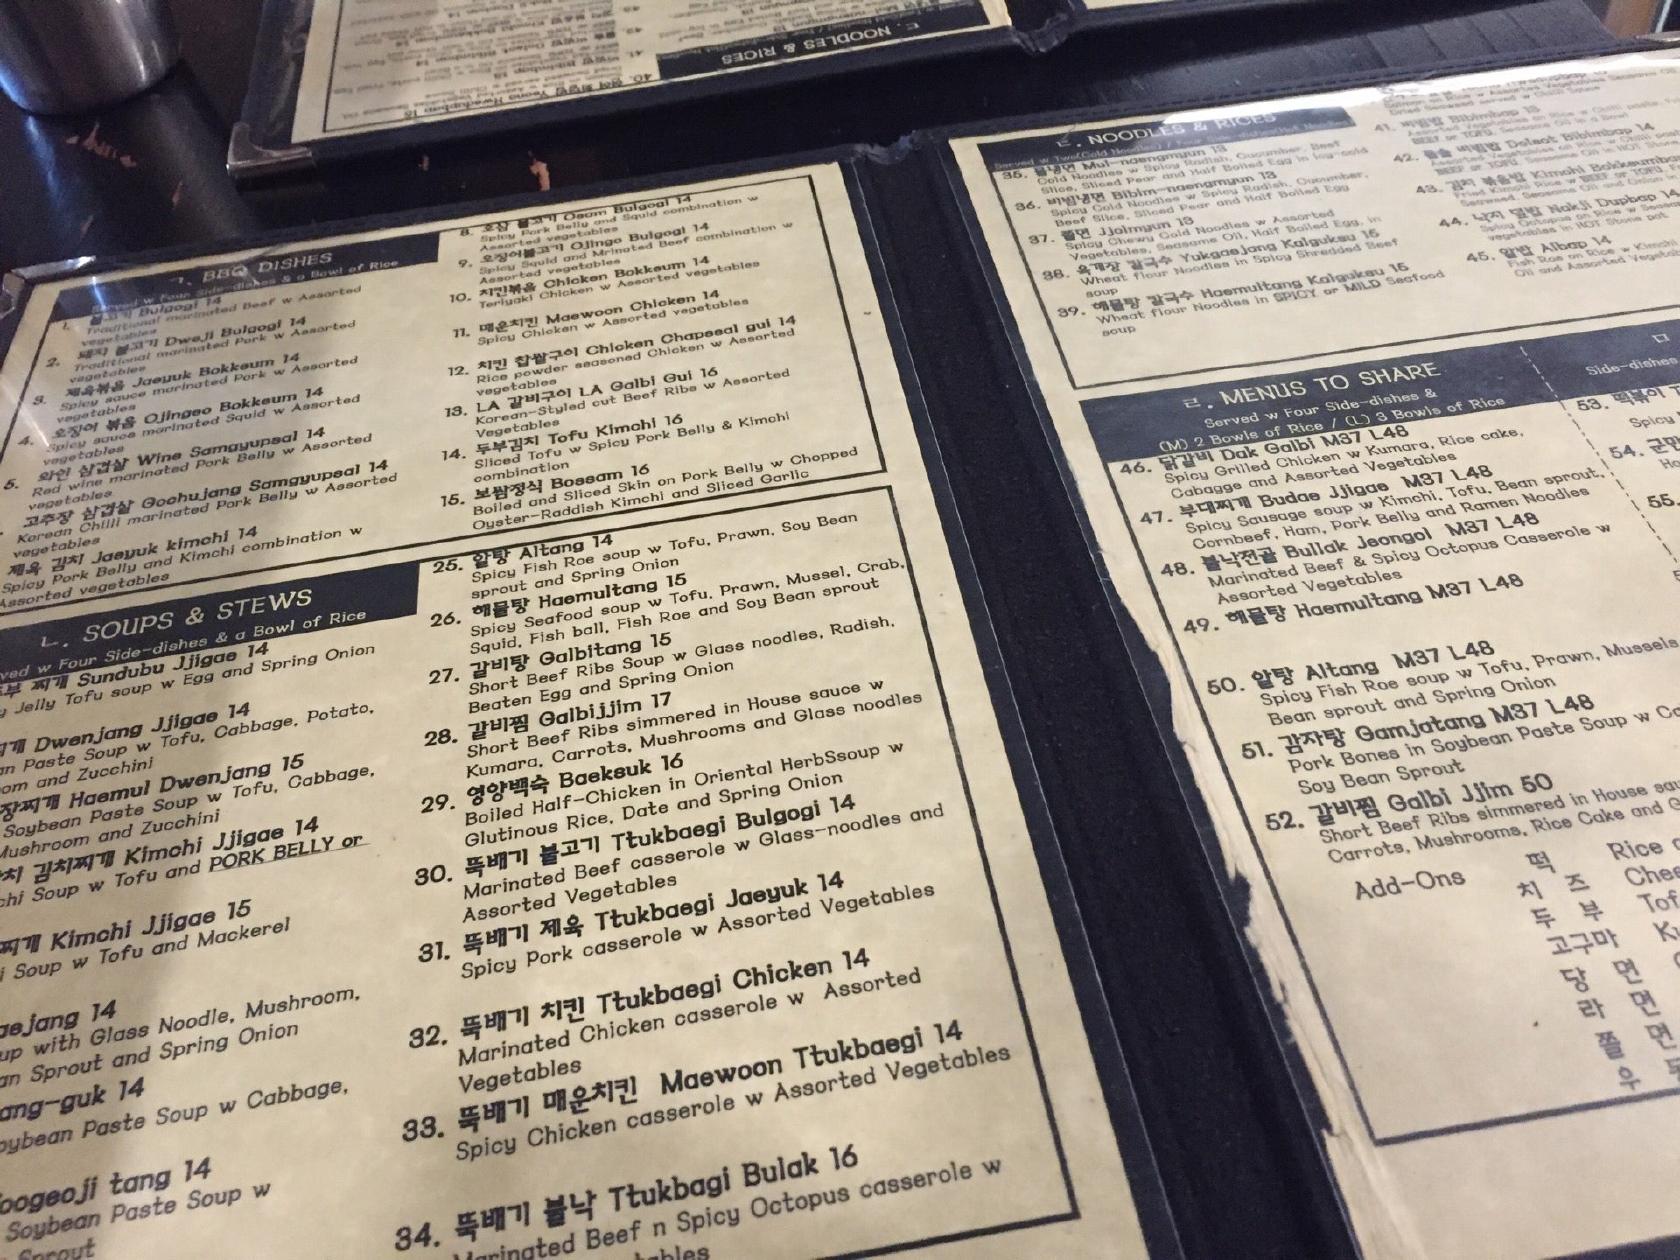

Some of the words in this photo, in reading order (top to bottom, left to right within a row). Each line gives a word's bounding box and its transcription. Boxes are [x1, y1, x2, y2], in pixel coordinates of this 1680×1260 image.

[803, 26, 891, 49] NOODLES
[450, 292, 471, 303] 10.
[479, 278, 536, 299] 치킨볶음
[543, 271, 607, 289] Chicken
[614, 260, 686, 279] Bokkeum
[692, 254, 709, 268] 14
[1095, 307, 1145, 325] Wheat
[1150, 304, 1187, 317] flour
[1192, 295, 1250, 312] Noodles
[1254, 292, 1269, 303] in
[1272, 284, 1315, 301] SPICY
[1323, 284, 1338, 294] or
[1342, 276, 1381, 291] MILD
[1385, 267, 1445, 286] Seafood
[453, 327, 470, 339] 11.
[479, 312, 538, 335] 매운치킨
[545, 304, 623, 324] Maewoon
[629, 293, 696, 312] Chicken
[702, 287, 719, 302] 14
[477, 331, 515, 346] Spicy
[521, 322, 578, 338] Chicken
[584, 320, 595, 329] w
[602, 307, 666, 327] Assorted
[672, 297, 749, 317] vegetables
[1218, 378, 1306, 407] MENUS
[1312, 373, 1349, 395] TO
[1358, 360, 1441, 389] SHARE
[442, 448, 466, 461] 14.
[475, 431, 539, 455] 두부김치
[547, 426, 588, 444] Tofu
[595, 415, 656, 437] Kimchi
[664, 411, 683, 426] 16
[1121, 461, 1152, 476] 46.
[1219, 443, 1259, 461] Dak
[1264, 436, 1315, 455] Galbi
[1320, 431, 1360, 448] M37
[1369, 425, 1409, 442] L48
[441, 492, 465, 507] 15.
[474, 475, 542, 502] 보쌈정식
[550, 468, 623, 489] Bossam
[631, 461, 649, 477] 16
[473, 496, 521, 516] Boiled
[528, 490, 556, 507] and
[563, 482, 611, 502] Sliced
[618, 477, 650, 493] Skin
[657, 475, 675, 487] on
[681, 465, 717, 484] Pork
[723, 459, 763, 477] Belly
[770, 458, 783, 470] w
[789, 443, 858, 467] Chopped
[51, 549, 84, 570] 김치
[91, 539, 158, 563] Jaeyuk
[165, 529, 228, 551] kimchi
[238, 524, 257, 540] 14
[433, 558, 463, 574] 25.
[472, 547, 511, 570] 알탕
[519, 540, 584, 561] Altang
[592, 532, 613, 550] 14
[471, 564, 515, 584] Spicy
[523, 555, 557, 574] Fish
[563, 553, 594, 568] Roe
[602, 546, 640, 562] soup
[647, 542, 661, 555] w
[781, 519, 810, 535] Soy
[816, 512, 857, 529] Bean
[1161, 562, 1195, 577] 48.
[1281, 535, 1348, 558] Bullak
[1357, 524, 1432, 548] Jeongol
[1444, 517, 1488, 537] M37
[1495, 510, 1539, 530] L48
[82, 610, 173, 643] SOUPS
[184, 605, 204, 626] &
[216, 587, 312, 621] STEWS
[430, 613, 461, 627] 26.
[538, 580, 657, 609] Haemultang
[666, 571, 686, 590] 15
[37, 662, 52, 674] w
[58, 654, 97, 671] Four
[104, 636, 207, 663] Side-dishes
[215, 630, 228, 645] &
[235, 630, 245, 642] a
[253, 619, 295, 639] Bowl
[302, 615, 322, 631] of
[329, 610, 366, 626] Rice
[429, 669, 459, 684] 27.
[469, 652, 530, 680] 갈비탕
[539, 639, 641, 668] Galbitang
[650, 631, 671, 650] 15
[1207, 677, 1245, 695] 50.
[1251, 664, 1294, 687] 알탕
[1305, 658, 1378, 679] Altang
[1391, 647, 1439, 668] M37
[1448, 640, 1495, 661] L48
[33, 724, 143, 752] Dwenjang
[150, 711, 218, 735] Jjigae
[229, 703, 250, 721] 14
[421, 794, 456, 813] 29.
[466, 772, 549, 805] 영양백숙
[558, 757, 652, 789] Baeksuk
[660, 752, 683, 773] 16
[1265, 812, 1304, 831] 52.
[1309, 795, 1379, 824] 갈비찜
[1387, 787, 1452, 812] Galbi
[1462, 780, 1514, 803] Jjim
[1520, 773, 1553, 793] 50
[1297, 779, 1335, 794] Soy
[1340, 771, 1390, 788] Bean
[1395, 758, 1465, 783] Sprout
[414, 864, 452, 886] 30.
[464, 846, 528, 878] 뚝배기
[539, 834, 599, 865] 불고기
[611, 815, 725, 852] Ttukbaegi
[735, 799, 820, 831] Bulgogi
[829, 793, 855, 815] 14
[1356, 872, 1466, 900] Add-Ons
[13, 960, 62, 980] Soup
[72, 955, 88, 969] w
[100, 944, 143, 964] Tofu
[151, 935, 188, 956] and
[197, 917, 290, 948] Mackerel
[50, 920, 131, 951] Kimchi
[141, 909, 216, 938] Jjigae
[228, 899, 250, 921] 15
[33, 1029, 80, 1054] with
[89, 1022, 149, 1044] Glass
[402, 1117, 445, 1142] 33.
[457, 1094, 529, 1132] 뚝배기
[543, 1076, 636, 1117] 매운치킨
[660, 1057, 782, 1094] Maewoon
[798, 1028, 923, 1071] Ttukbaegi
[936, 1021, 963, 1046] 14
[456, 1131, 516, 1159] Spicy
[527, 1115, 616, 1145] Chicken
[626, 1092, 735, 1128] casserole
[745, 1090, 763, 1108] w
[774, 1066, 876, 1103] Assorted
[885, 1047, 1011, 1084] Vegetables
